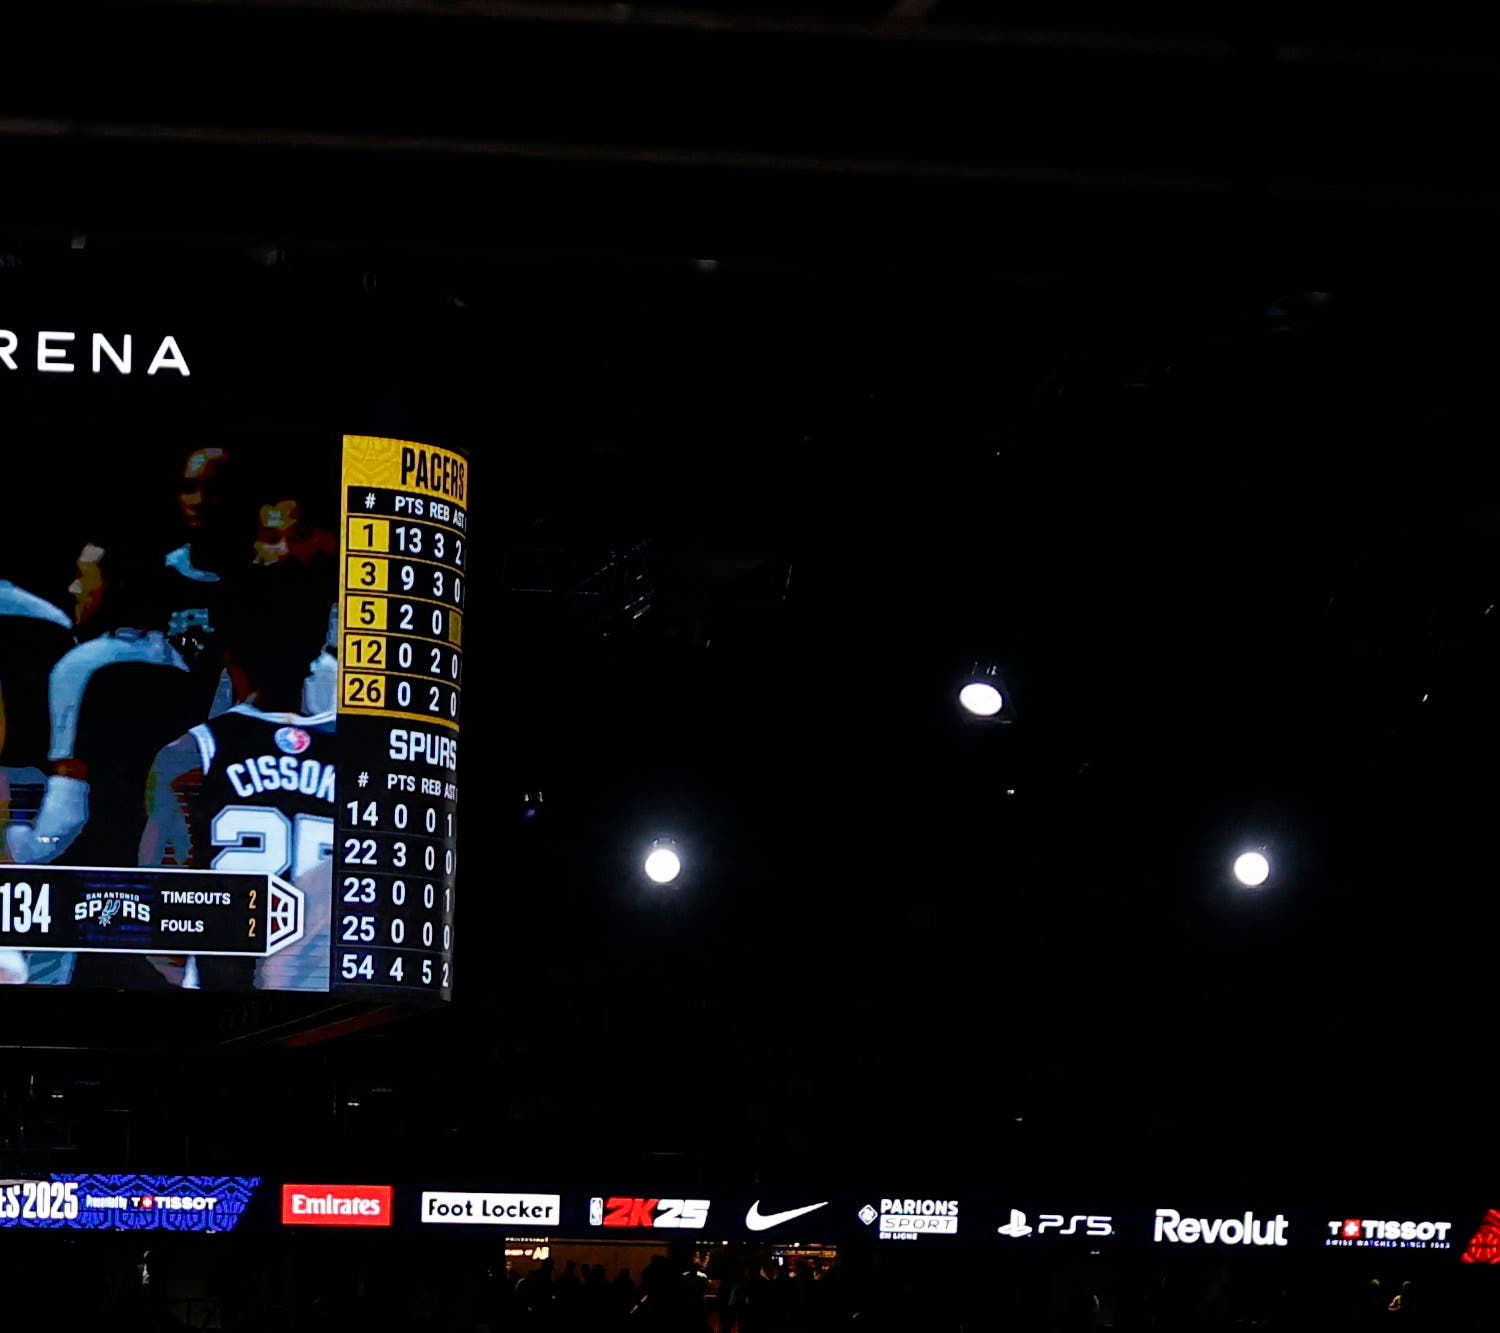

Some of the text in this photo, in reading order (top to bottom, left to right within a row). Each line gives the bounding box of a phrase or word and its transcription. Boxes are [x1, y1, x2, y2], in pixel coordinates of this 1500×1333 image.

[401, 446, 465, 502] PACERS
[364, 492, 465, 529] # PTS REB AST
[363, 523, 373, 548] 1
[360, 561, 376, 586] 3
[359, 601, 376, 626] 5
[351, 639, 383, 665] 12
[348, 677, 382, 703] 26
[389, 728, 457, 771] SPURS
[357, 771, 456, 801] # PTS REB AST
[347, 801, 379, 827] 14
[344, 839, 378, 865] 22
[86, 891, 140, 902] SAN ANTONIO
[161, 890, 257, 909] TIMEOUTS 2
[343, 877, 376, 904] 23
[0, 882, 51, 933] 134
[74, 899, 151, 926] SPURS
[161, 918, 256, 938] FOULS 2
[342, 915, 375, 942] 25
[341, 954, 374, 980] 54
[22, 1182, 79, 1219] 2025
[154, 1197, 217, 1210] TISSOT
[291, 1194, 380, 1216] Emirates
[428, 1198, 553, 1219] Foot Locker
[603, 1197, 711, 1228] 2K25
[880, 1199, 959, 1216] PARIONS
[885, 1219, 954, 1229] SPORT
[1038, 1214, 1113, 1236] PS5
[1154, 1208, 1288, 1246] Revolut
[1361, 1220, 1451, 1241] TISSOT
